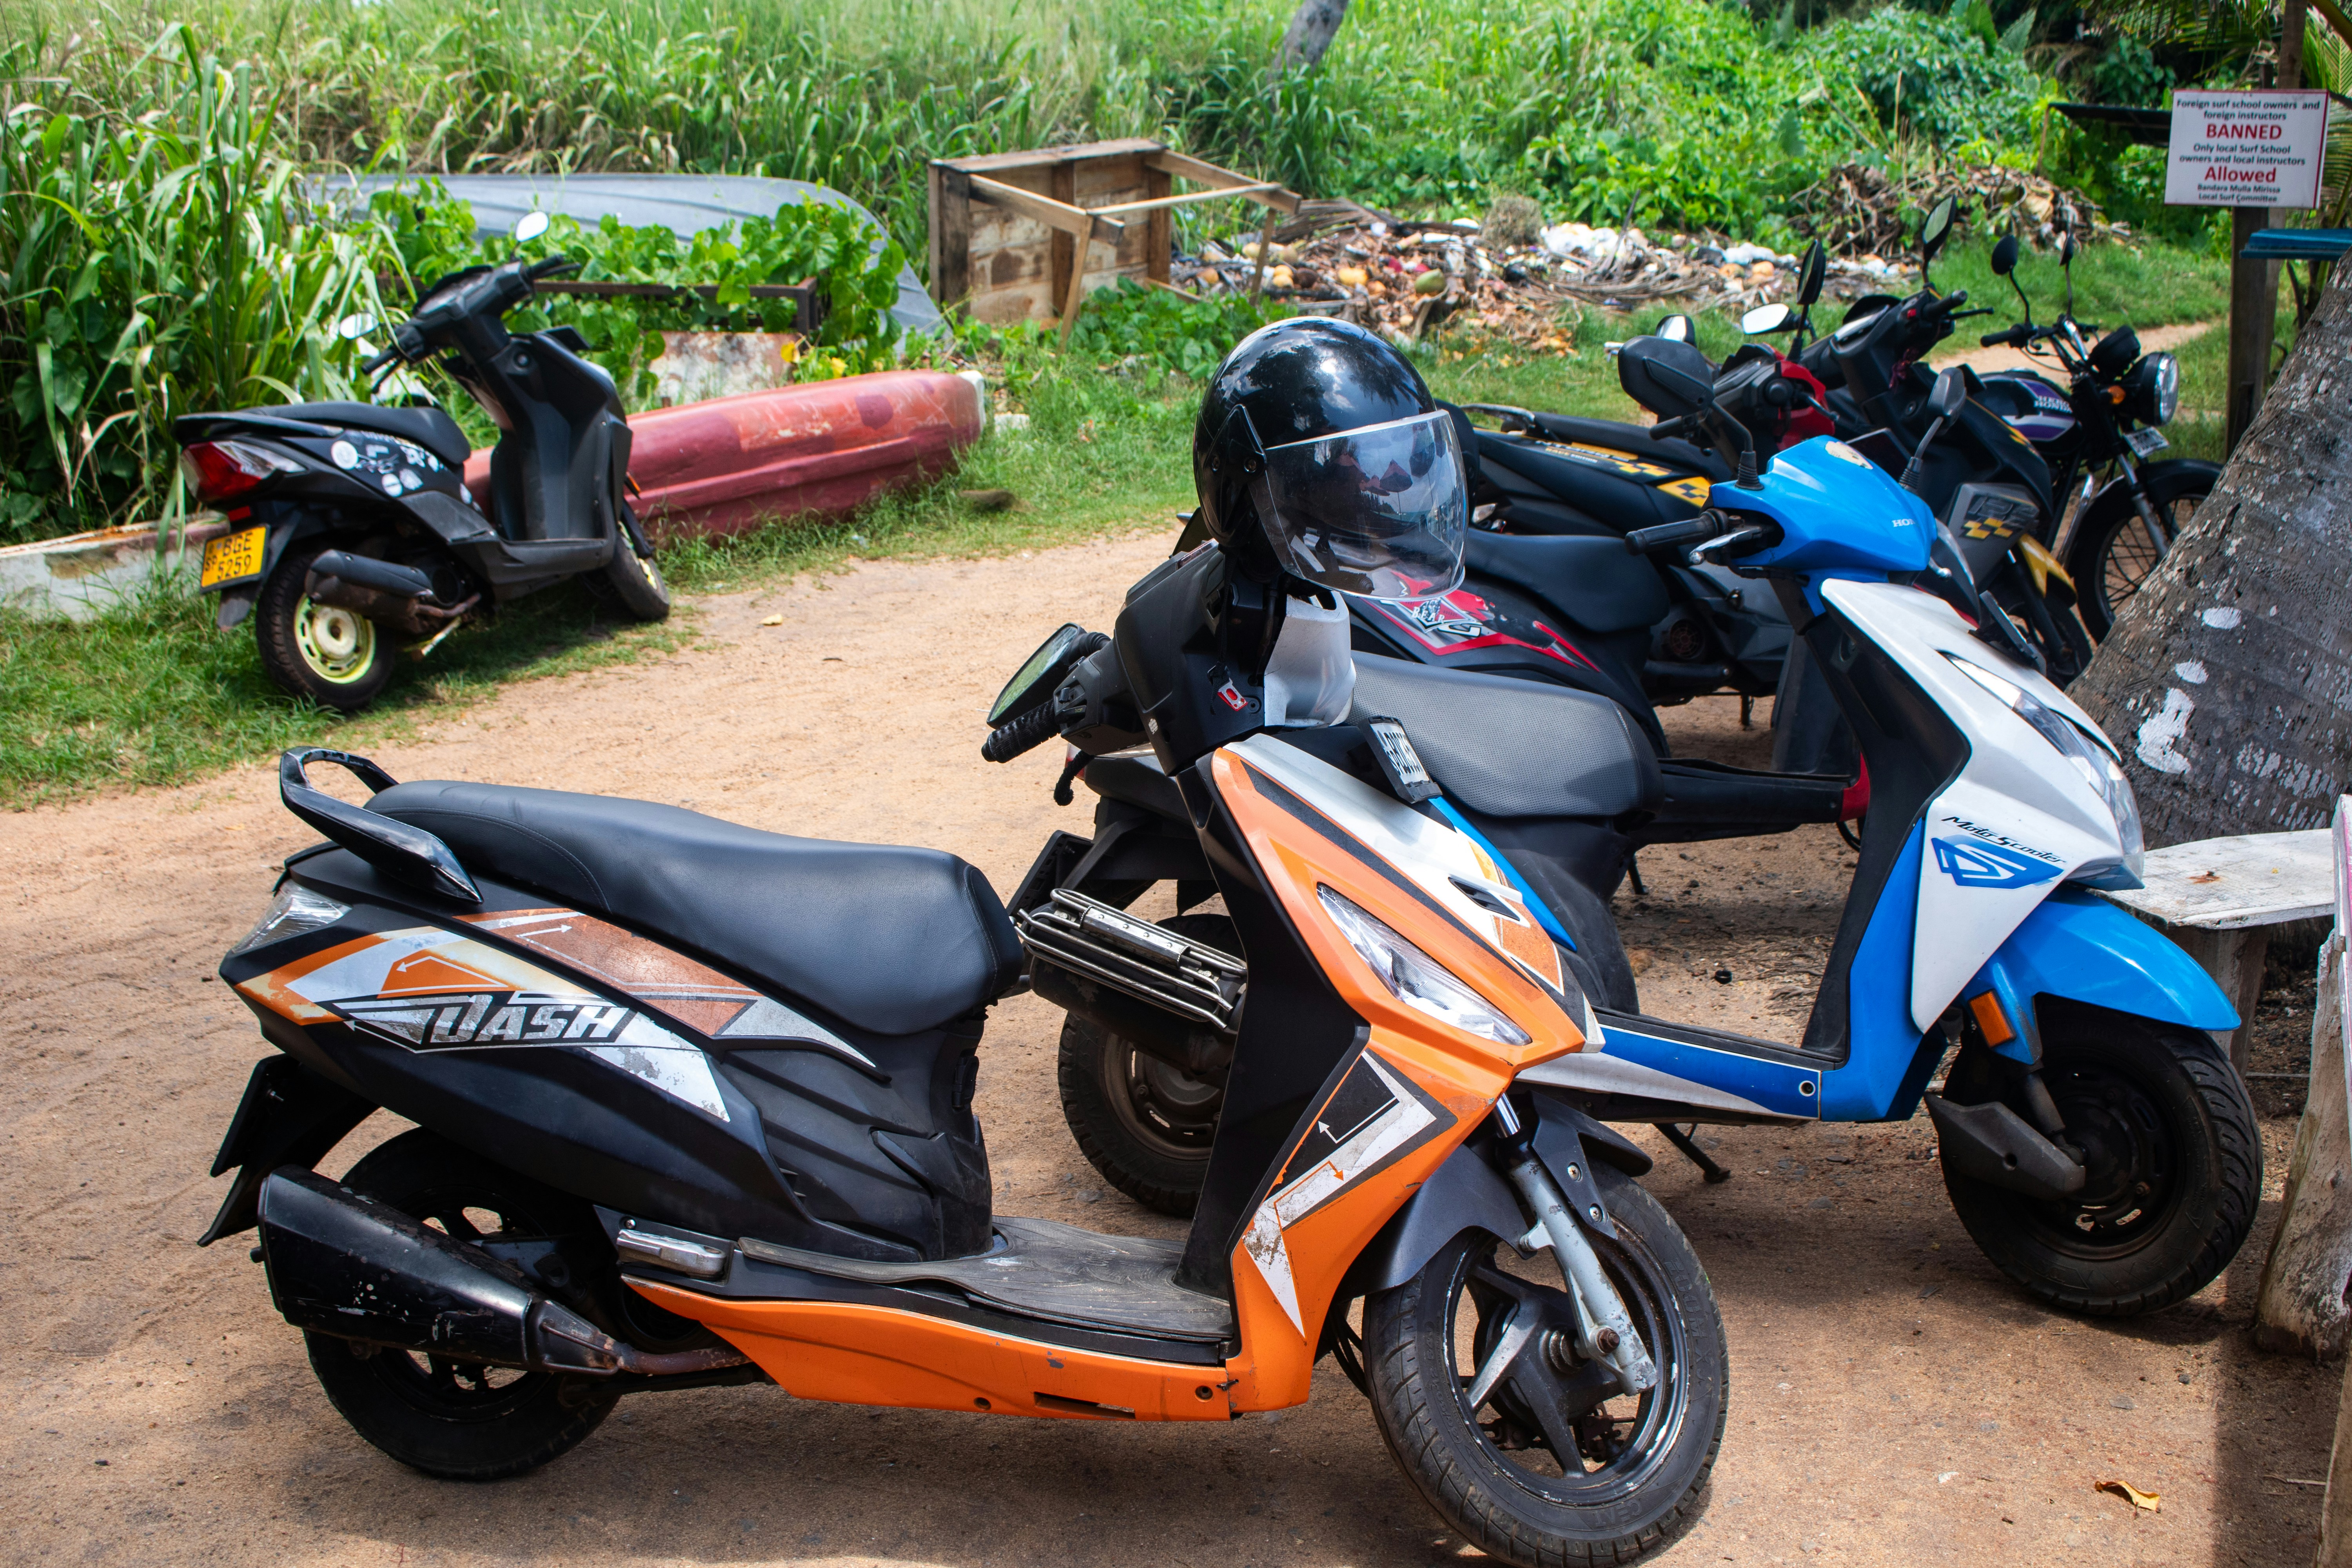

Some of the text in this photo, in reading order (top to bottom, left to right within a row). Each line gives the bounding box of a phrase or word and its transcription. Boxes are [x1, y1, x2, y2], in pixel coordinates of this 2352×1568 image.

[2176, 100, 2320, 111] Foreign surf school owners and
[2203, 111, 2286, 122] foreign instructors
[2206, 123, 2282, 140] BANNED
[2193, 144, 2290, 154] Only local Surf School
[2214, 155, 2231, 163] and
[2233, 156, 2254, 164] local
[2256, 156, 2305, 166] instructors
[2204, 165, 2276, 183] Allowed
[2219, 193, 2234, 201] Surf
[223, 532, 253, 557] BGE
[217, 554, 252, 581] 5259
[1411, 606, 1445, 625] BEAR
[1991, 837, 2066, 863] Scooter
[430, 994, 630, 1043] DASH
[1595, 1498, 1642, 1527] CEAT
